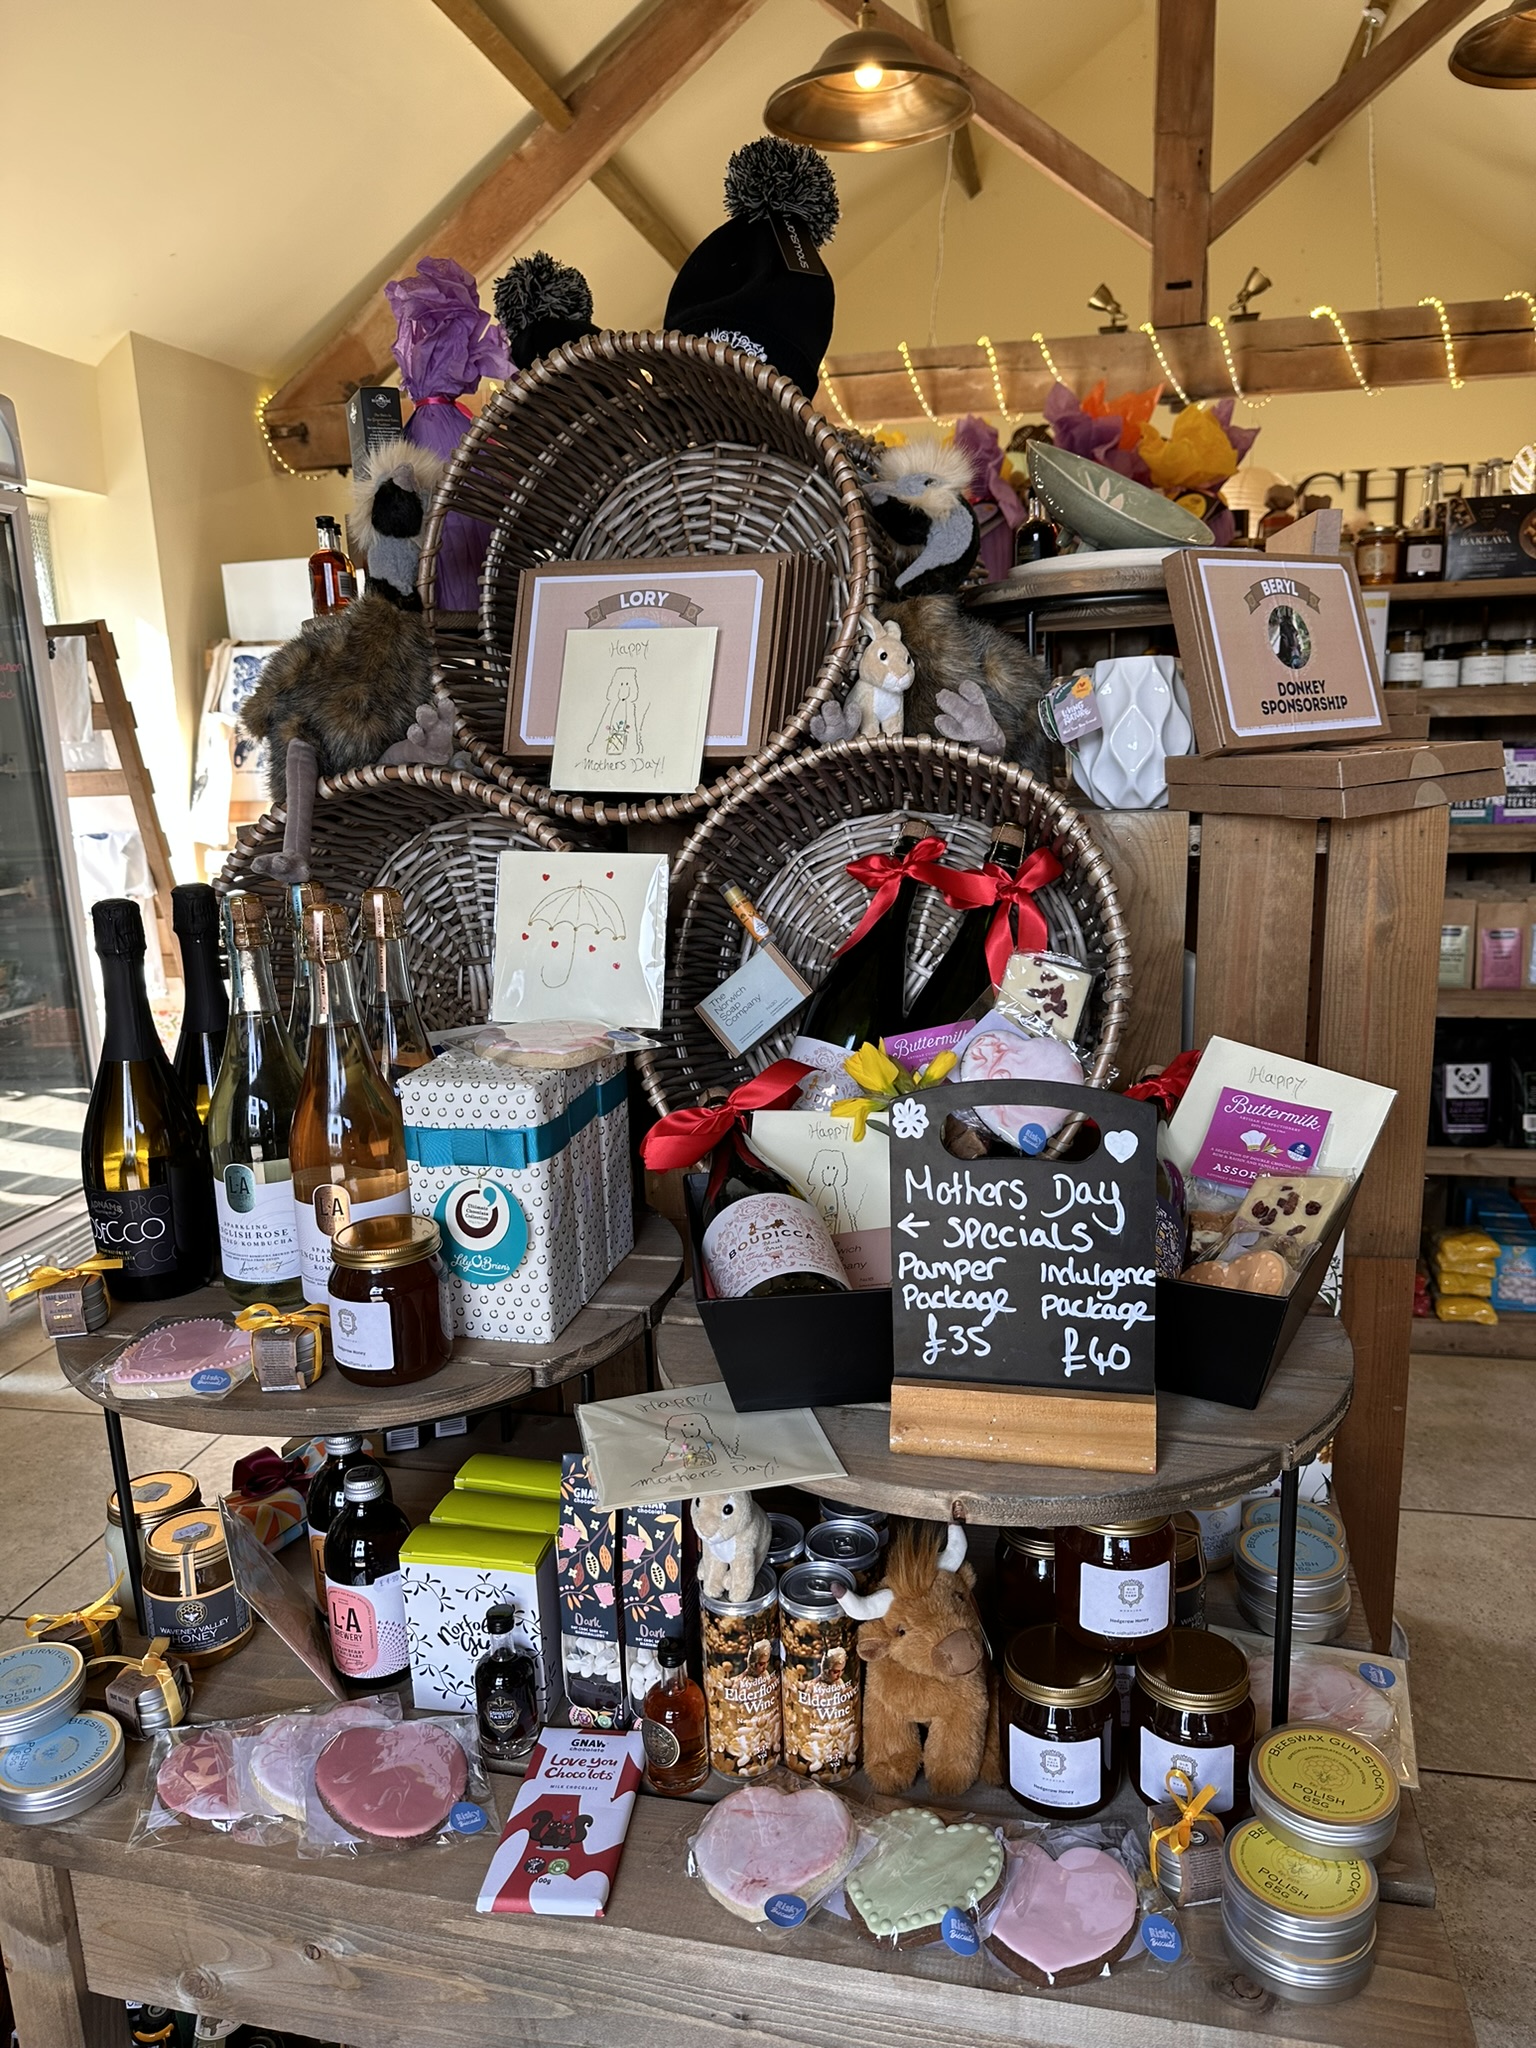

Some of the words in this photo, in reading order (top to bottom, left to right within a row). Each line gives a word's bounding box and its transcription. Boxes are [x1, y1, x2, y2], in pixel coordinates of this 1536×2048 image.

[1260, 578, 1299, 597] BERYL
[620, 591, 670, 609] LORY
[609, 639, 650, 660] Happy
[1277, 680, 1326, 697] DONKEY
[1261, 695, 1348, 715] SPONSORSHIP
[1507, 798, 1523, 808] TEA
[708, 992, 726, 1007] The
[714, 985, 747, 1015] Norwich
[719, 1000, 742, 1021] Soap
[725, 993, 762, 1027] Company
[1249, 1065, 1307, 1099] Happy
[1224, 1094, 1320, 1132] Buttermilk
[808, 1122, 850, 1141] Happy
[1213, 1163, 1258, 1180] ASSOR
[905, 1165, 1028, 1210] Mothers
[1040, 1173, 1126, 1235] Day
[223, 1221, 268, 1230] SPARKLING
[256, 1228, 289, 1239] ROSE
[241, 1238, 293, 1247] KOMBUCHA
[728, 1229, 816, 1260] BOUDICCA
[898, 1251, 1007, 1285] Pamper
[1040, 1256, 1156, 1300] Indulgence
[902, 1285, 1017, 1327] Package
[1040, 1294, 1156, 1330] Package
[922, 1313, 991, 1366] £35
[1061, 1326, 1131, 1378] £40
[159, 1626, 197, 1637] WAVENEY
[199, 1616, 229, 1633] VALLEY
[574, 1612, 602, 1628] Dark
[171, 1628, 218, 1644] HONEY
[640, 1624, 666, 1638] Dark
[21, 1648, 71, 1666] FURNITURE
[744, 1696, 775, 1714] Wine
[817, 1705, 850, 1720] Wine
[571, 1738, 606, 1748] GNAW
[17, 1741, 36, 1771] POLISH
[50, 1740, 108, 1783] FURNITURE
[550, 1753, 587, 1767] Love
[1268, 1734, 1325, 1757] BEESWAX
[1329, 1737, 1361, 1755] GUN
[1361, 1755, 1385, 1792] STOCK
[1292, 1782, 1345, 1806] POLISH
[1302, 1795, 1329, 1809] 65G
[456, 1810, 480, 1821] Risky
[1258, 1867, 1309, 1899] POLISH
[1264, 1881, 1290, 1899] 65G
[774, 1900, 803, 1917] Risky
[950, 1918, 974, 1935] Risky
[1149, 1927, 1175, 1942] Risky
[949, 1929, 975, 1944] Biscuits
[1150, 1937, 1176, 1949] Biscuits
